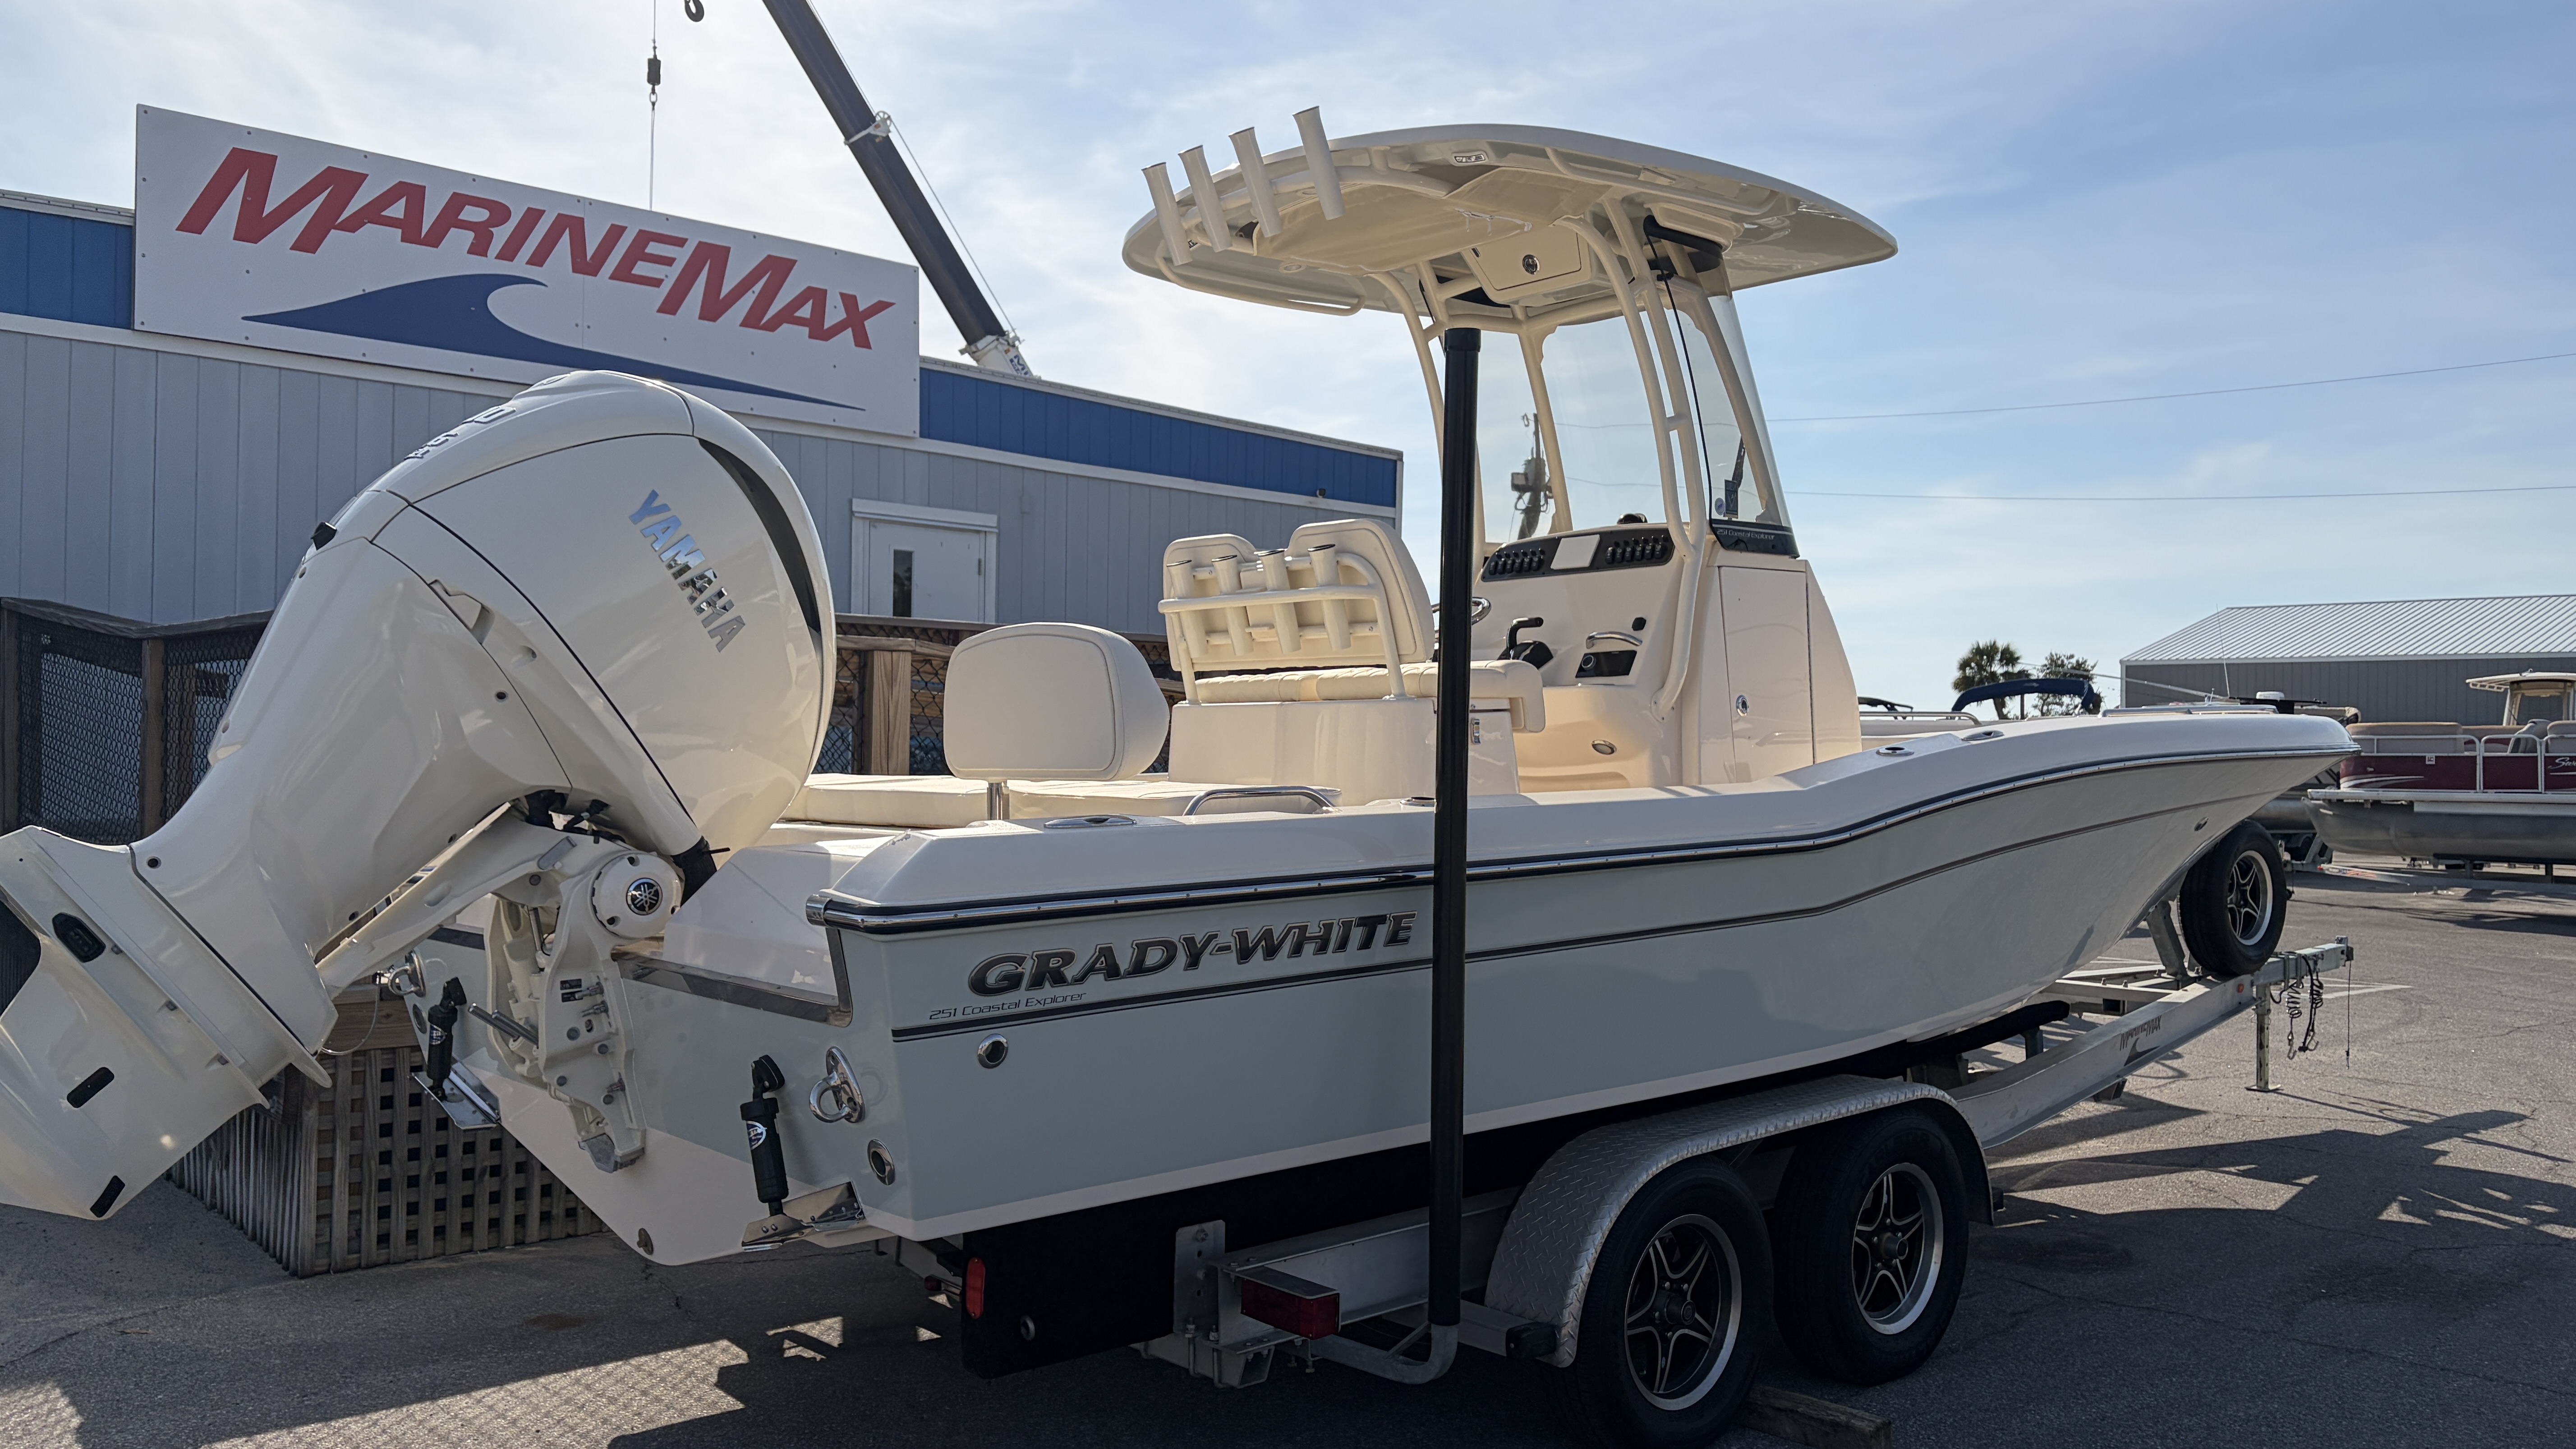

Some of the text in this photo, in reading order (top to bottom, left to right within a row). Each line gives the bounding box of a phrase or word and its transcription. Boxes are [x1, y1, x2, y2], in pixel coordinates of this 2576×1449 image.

[176, 147, 896, 350] MARINEMAX
[629, 489, 745, 653] YAMAHA
[929, 993, 1087, 1020] 251 Coastal Explorer
[968, 910, 1418, 997] GRADY-WHITE
